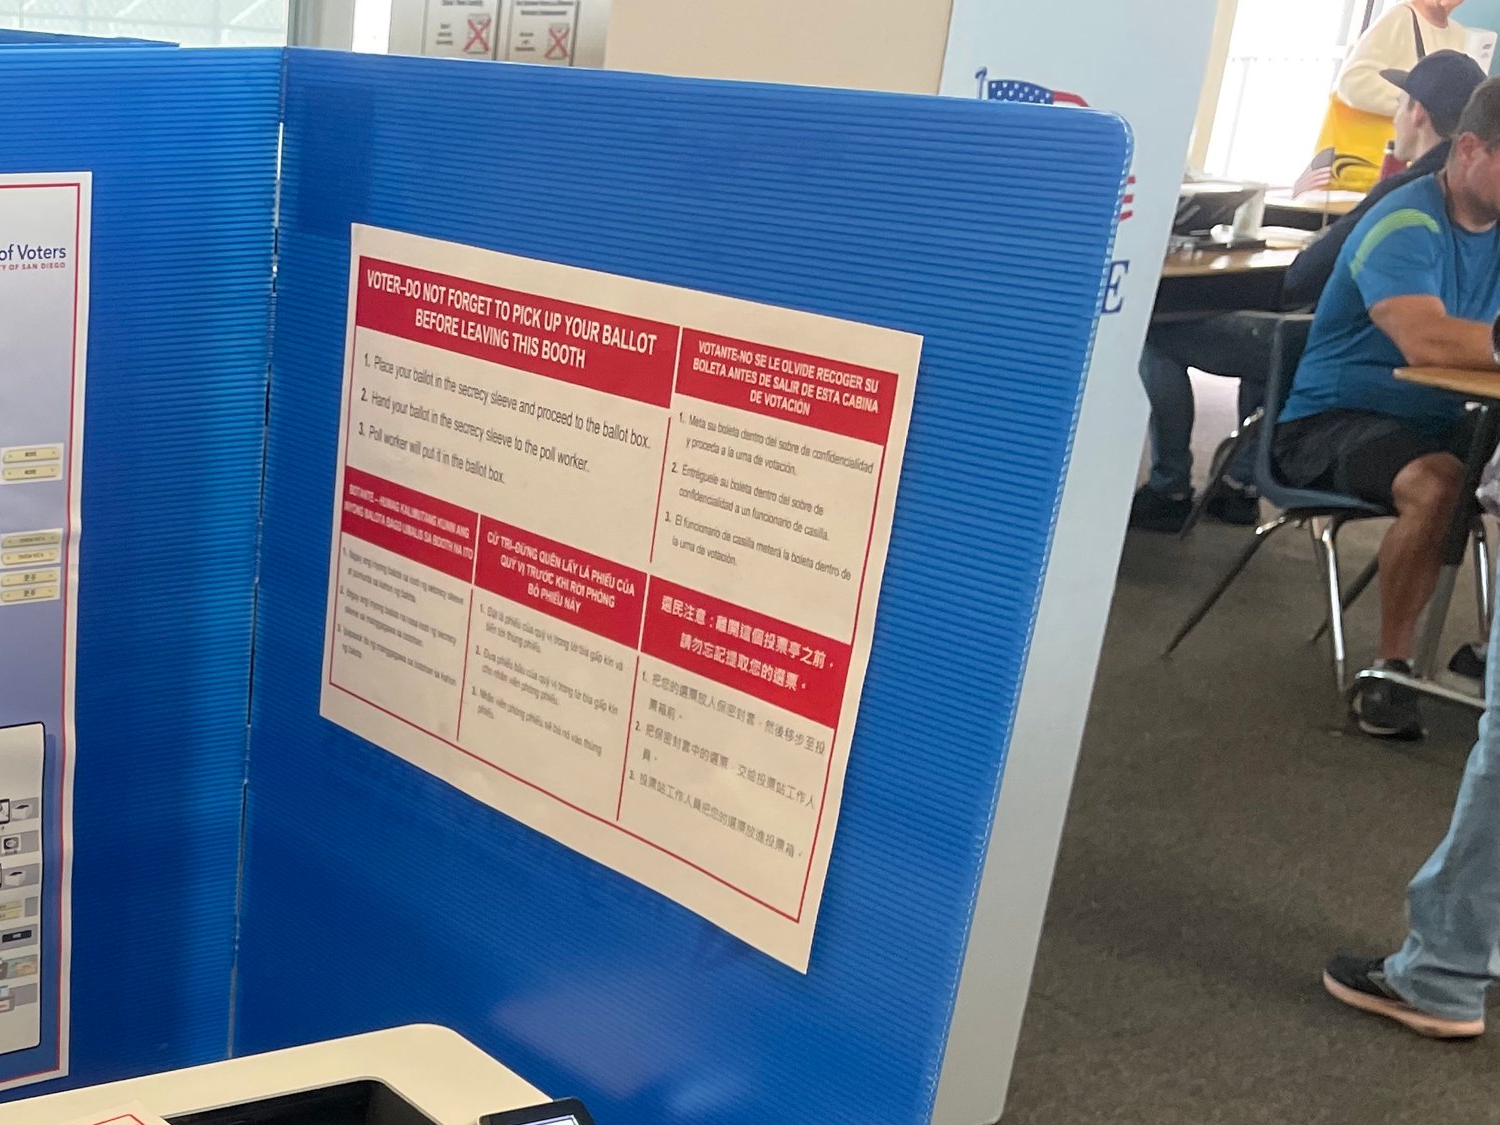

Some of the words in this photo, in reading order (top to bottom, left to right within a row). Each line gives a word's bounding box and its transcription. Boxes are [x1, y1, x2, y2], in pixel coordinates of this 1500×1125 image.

[17, 243, 67, 263] Voters
[40, 261, 65, 269] DIEGO
[415, 308, 459, 336] BEFORE
[460, 319, 508, 349] LEAVING
[512, 332, 538, 356] THIS
[541, 339, 585, 368] BOOTH
[422, 282, 446, 304] NOT
[447, 288, 492, 315] FORGET
[494, 299, 510, 320] TO
[512, 303, 541, 328] PICK
[544, 310, 561, 331] UP
[564, 315, 599, 342] YOUR
[602, 324, 657, 355] BALLOT
[754, 353, 767, 367] SE
[767, 356, 780, 370] LE
[781, 359, 815, 378] OLVIDE
[815, 367, 863, 389] RECOGER
[864, 377, 878, 393] SU
